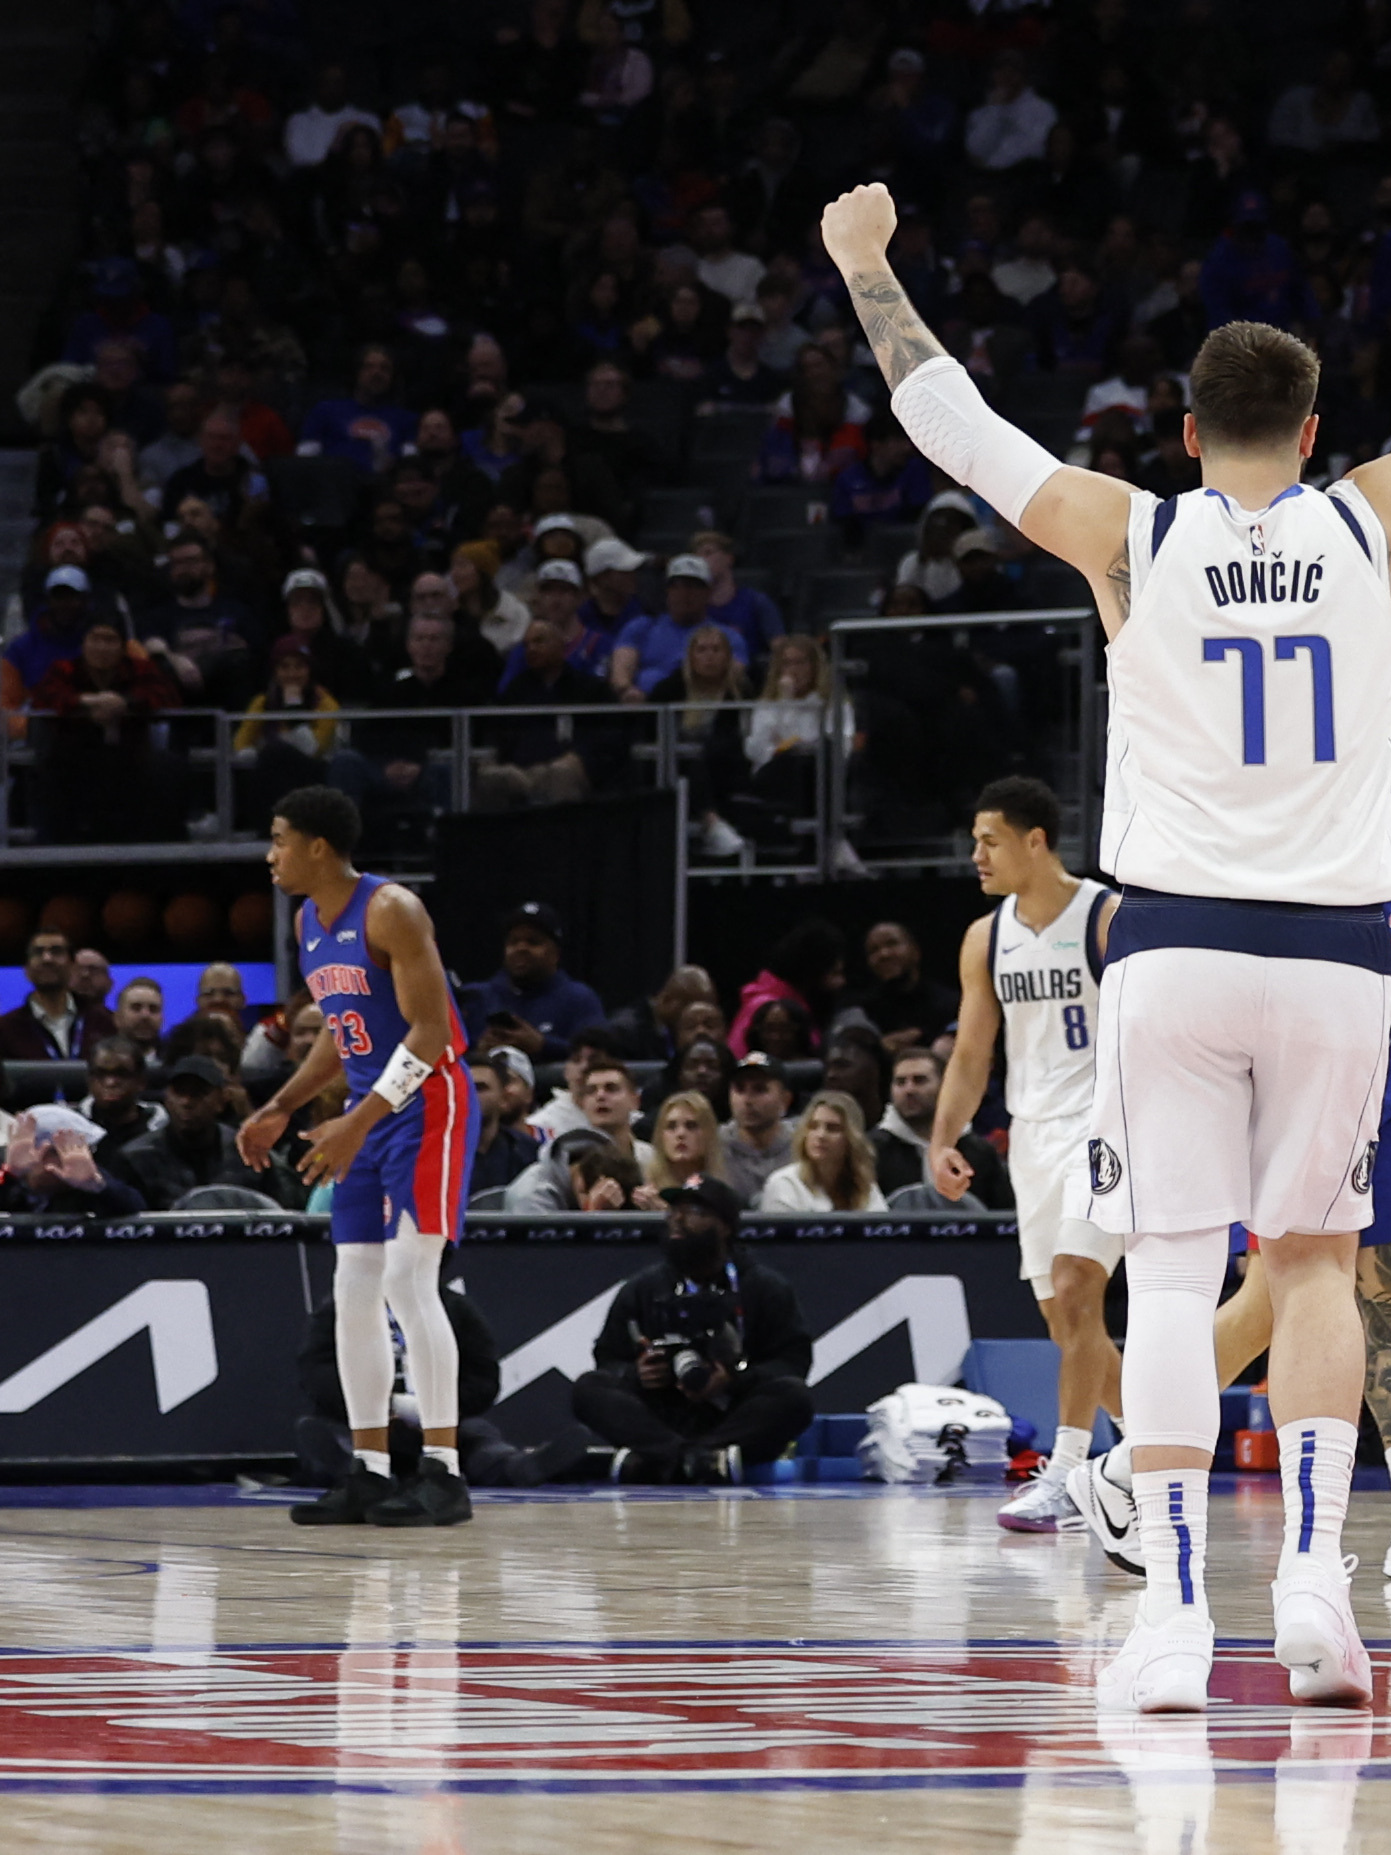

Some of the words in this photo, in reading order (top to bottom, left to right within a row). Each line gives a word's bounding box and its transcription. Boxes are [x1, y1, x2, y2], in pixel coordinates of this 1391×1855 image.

[1204, 551, 1325, 607] DONČIĆ
[1201, 634, 1337, 766] 77
[1000, 968, 1082, 1004] DALLAS
[327, 1010, 373, 1059] 23
[1062, 1004, 1090, 1051] 8
